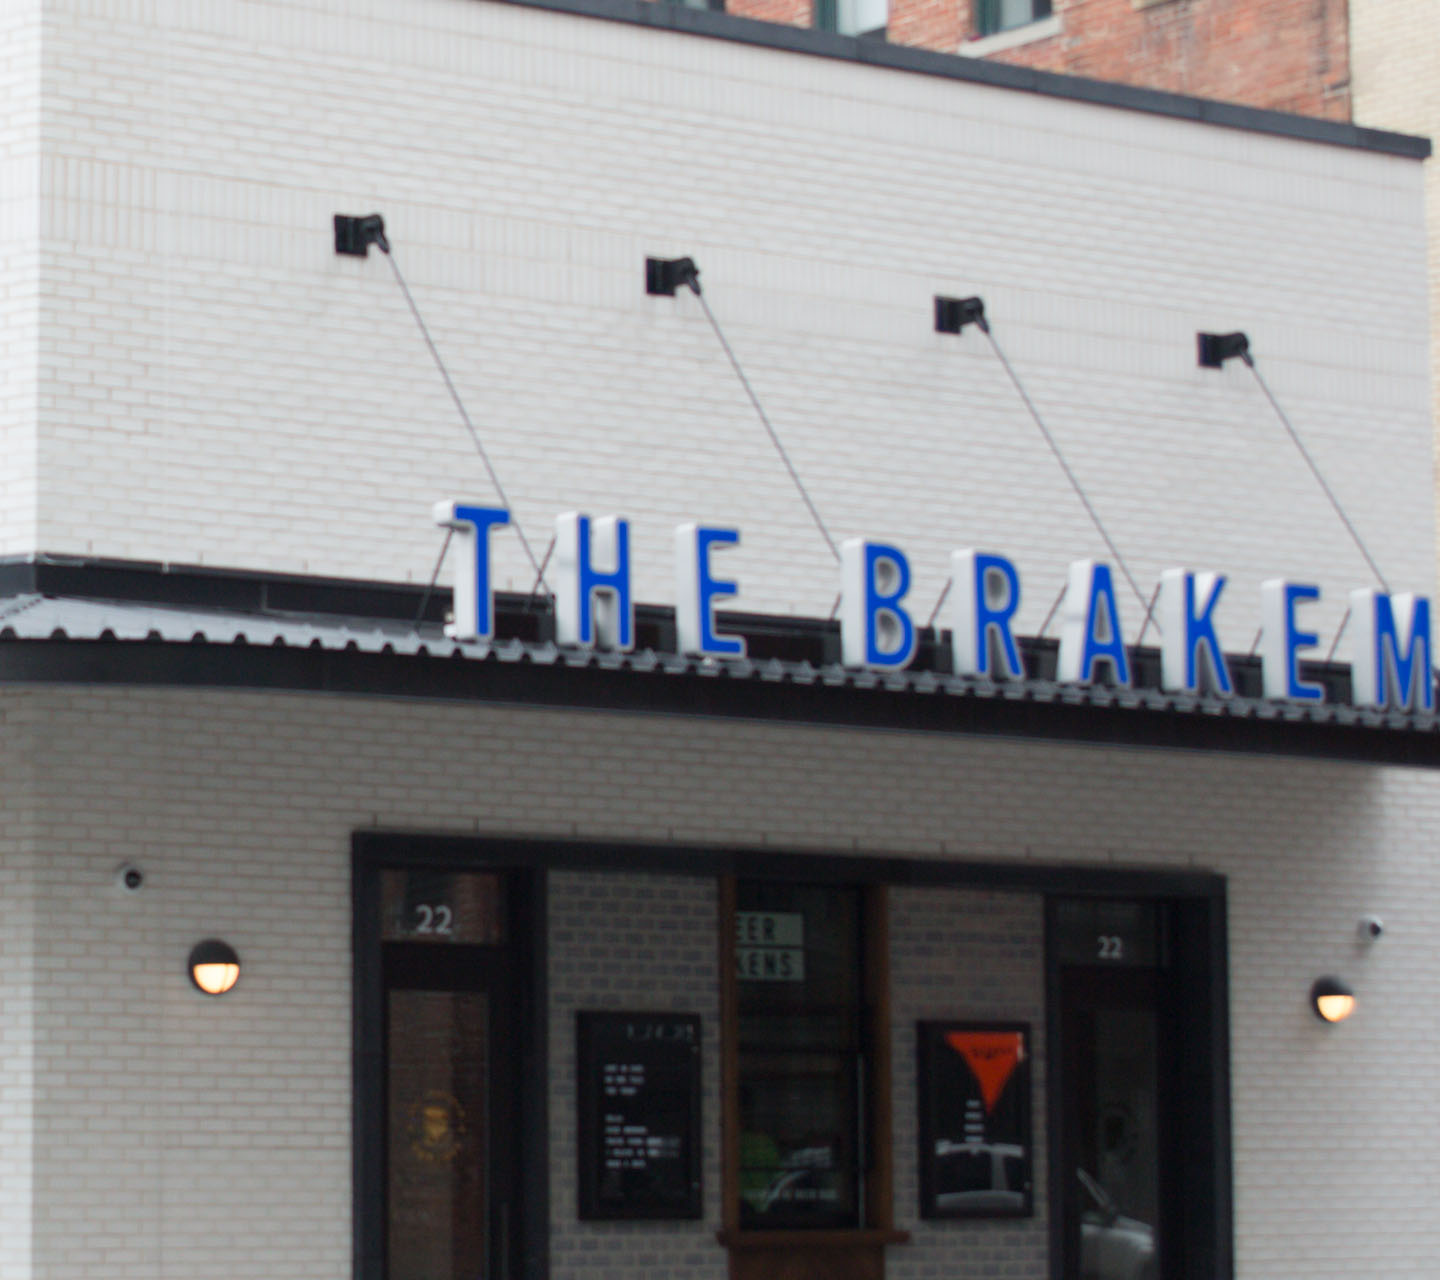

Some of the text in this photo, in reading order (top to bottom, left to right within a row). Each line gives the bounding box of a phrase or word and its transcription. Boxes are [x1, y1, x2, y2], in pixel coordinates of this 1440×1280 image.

[448, 503, 746, 657] THE
[416, 904, 452, 934] 22
[1096, 935, 1124, 959] 22
